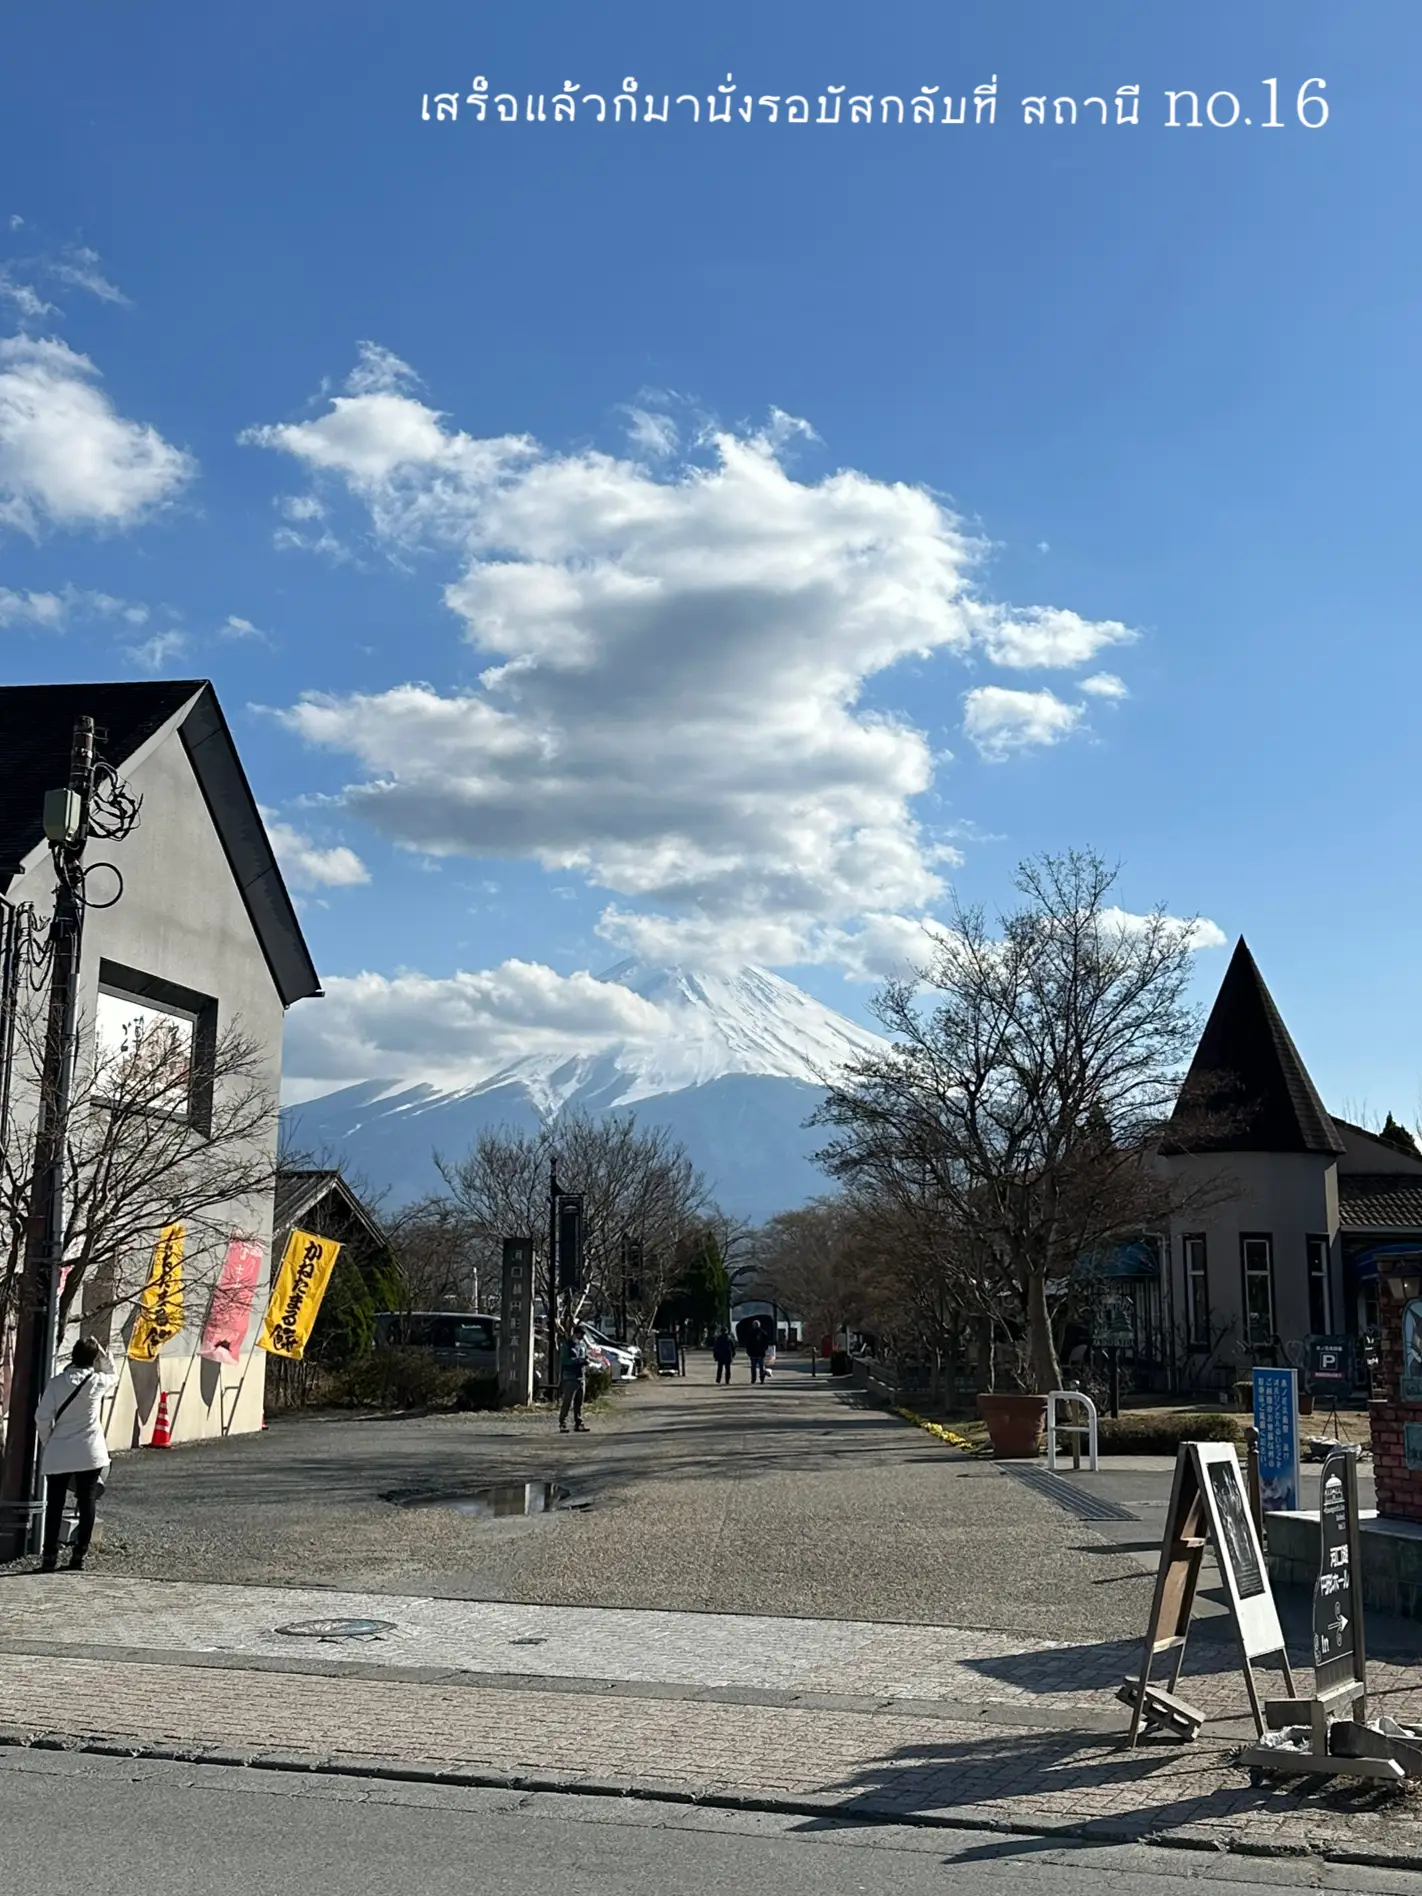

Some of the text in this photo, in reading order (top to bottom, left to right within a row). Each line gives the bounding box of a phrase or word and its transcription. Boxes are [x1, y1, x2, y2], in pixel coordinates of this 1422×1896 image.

[269, 1240, 323, 1353] かねたまる餅
[1322, 1354, 1336, 1368] P
